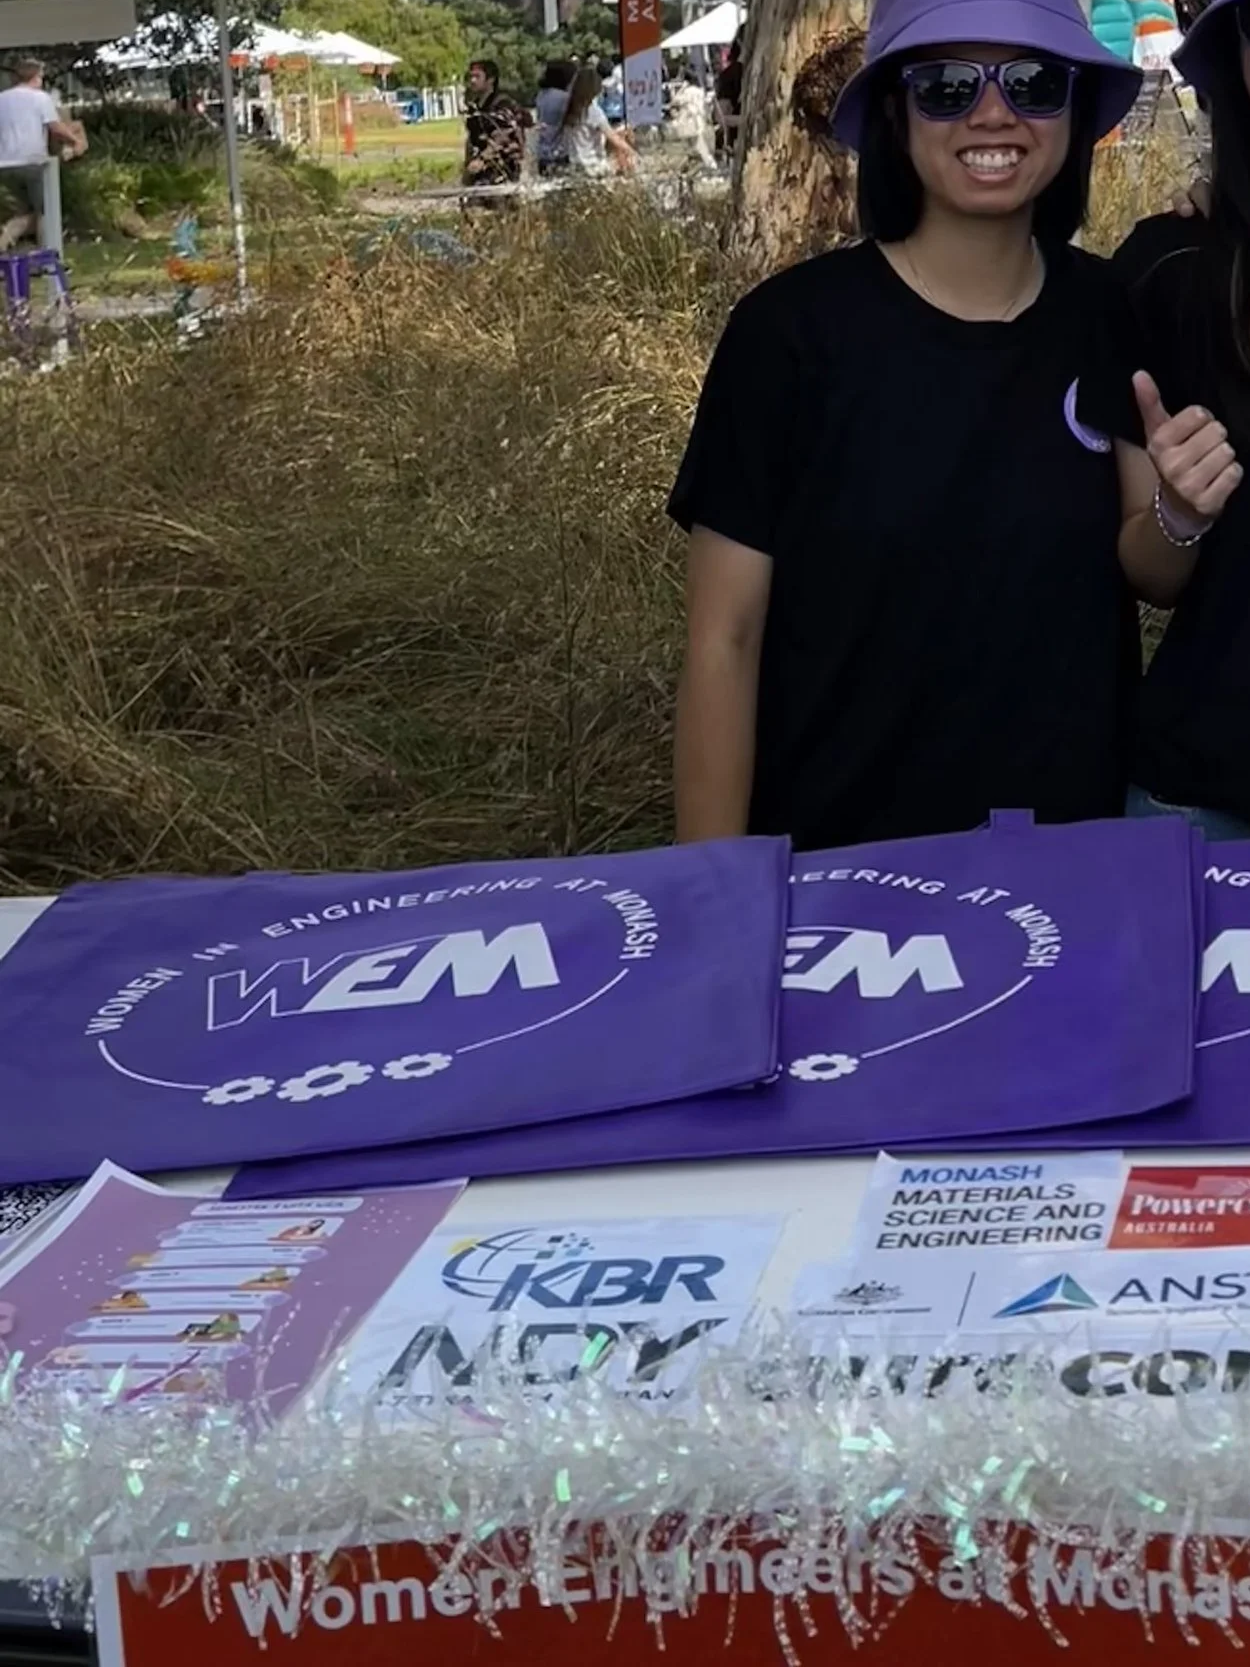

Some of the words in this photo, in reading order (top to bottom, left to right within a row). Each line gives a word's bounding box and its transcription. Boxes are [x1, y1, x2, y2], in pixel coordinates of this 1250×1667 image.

[85, 968, 183, 1036] WOMEN
[192, 941, 240, 962] IN
[262, 877, 543, 938] ENGINEERING
[553, 877, 608, 893] AT
[602, 889, 660, 961] MONASH
[957, 886, 1011, 906] AT
[1005, 903, 1062, 969] MONASH
[206, 921, 561, 1032] WEM
[782, 930, 965, 999] EM
[892, 1183, 1077, 1207] MATERIALS
[900, 1164, 1044, 1185] MONASH
[875, 1223, 1105, 1250] ENGINEERING
[883, 1204, 1028, 1227] SCIENCE
[1033, 1202, 1107, 1221] AND
[1122, 1220, 1216, 1234] AUSTRALIA
[489, 1254, 726, 1312] KBR
[230, 1567, 523, 1638] Women
